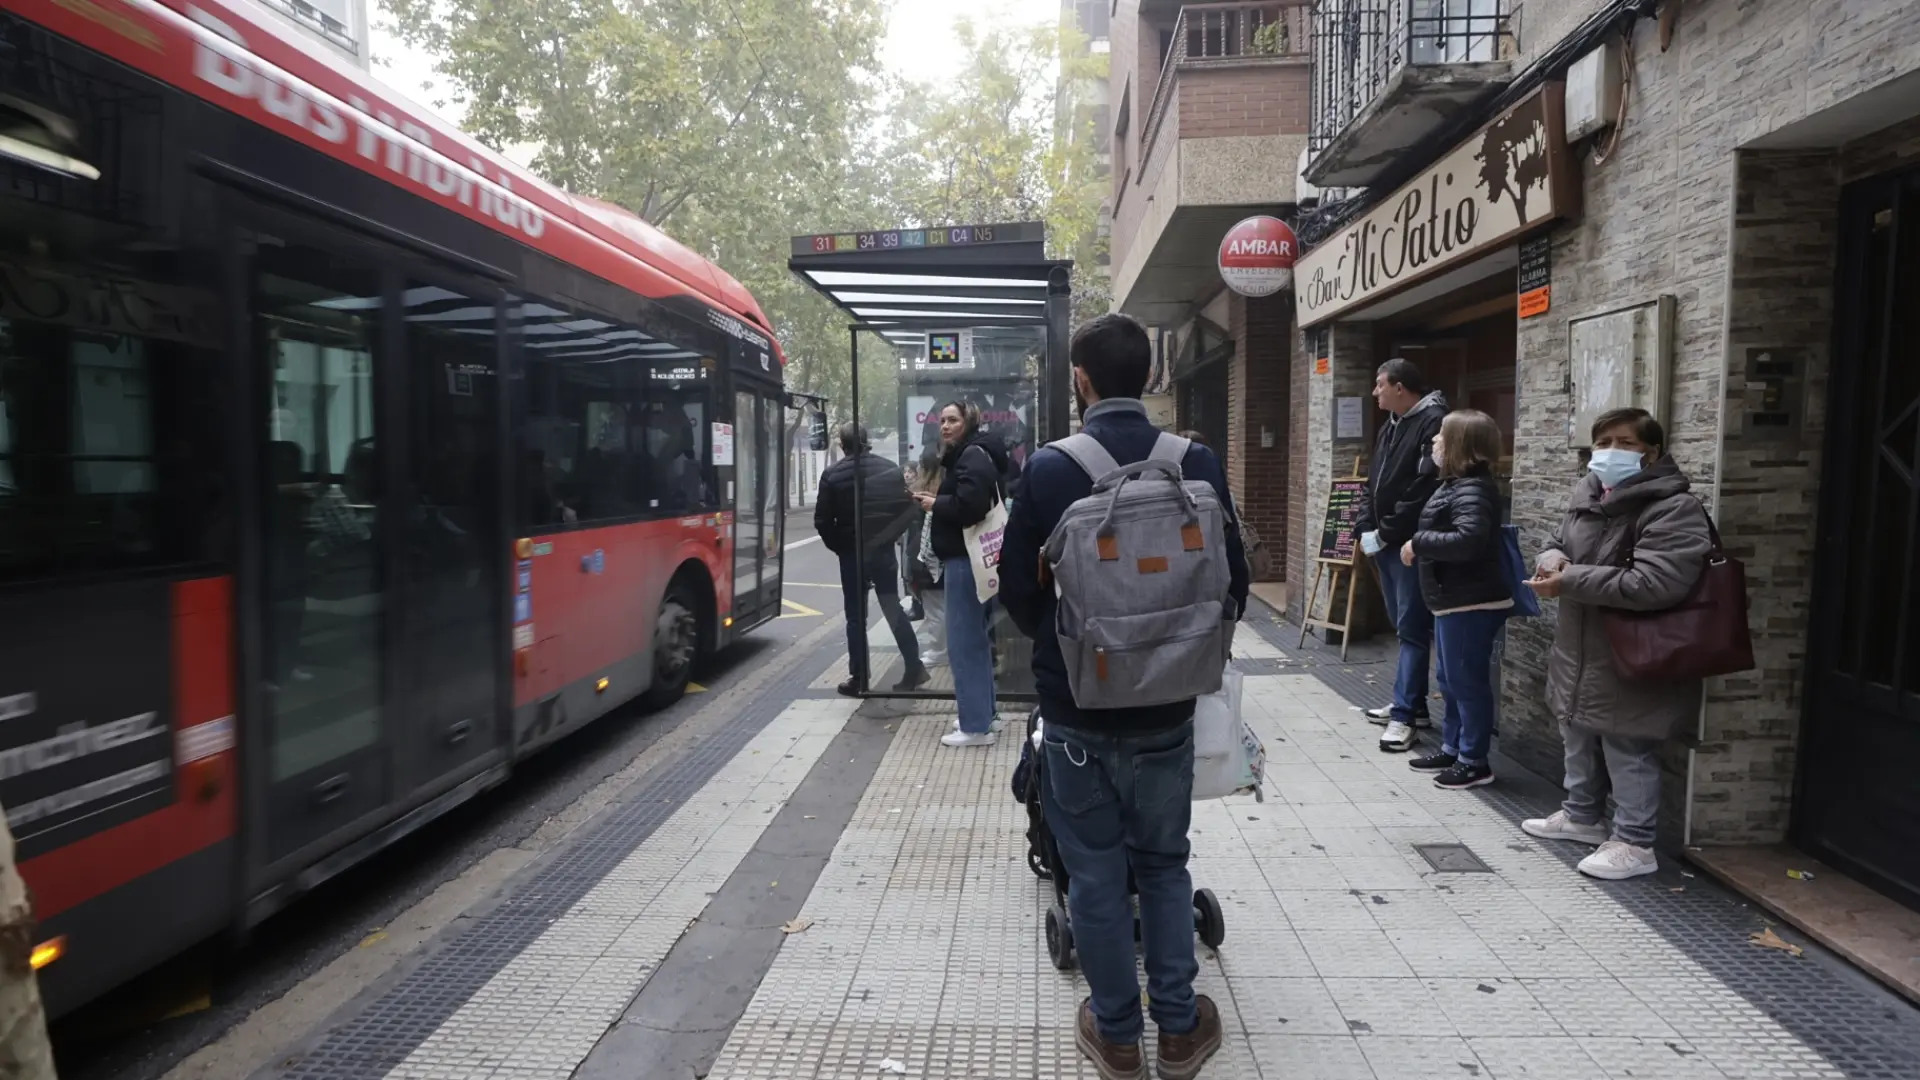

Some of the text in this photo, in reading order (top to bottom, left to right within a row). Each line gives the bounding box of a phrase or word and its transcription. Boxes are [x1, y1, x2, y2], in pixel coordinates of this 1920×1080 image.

[816, 227, 993, 250] 31 33 34 39 42 C1 C4 N5
[1227, 239, 1291, 256] AMBAR
[1307, 172, 1480, 310] Bar Mi Patio
